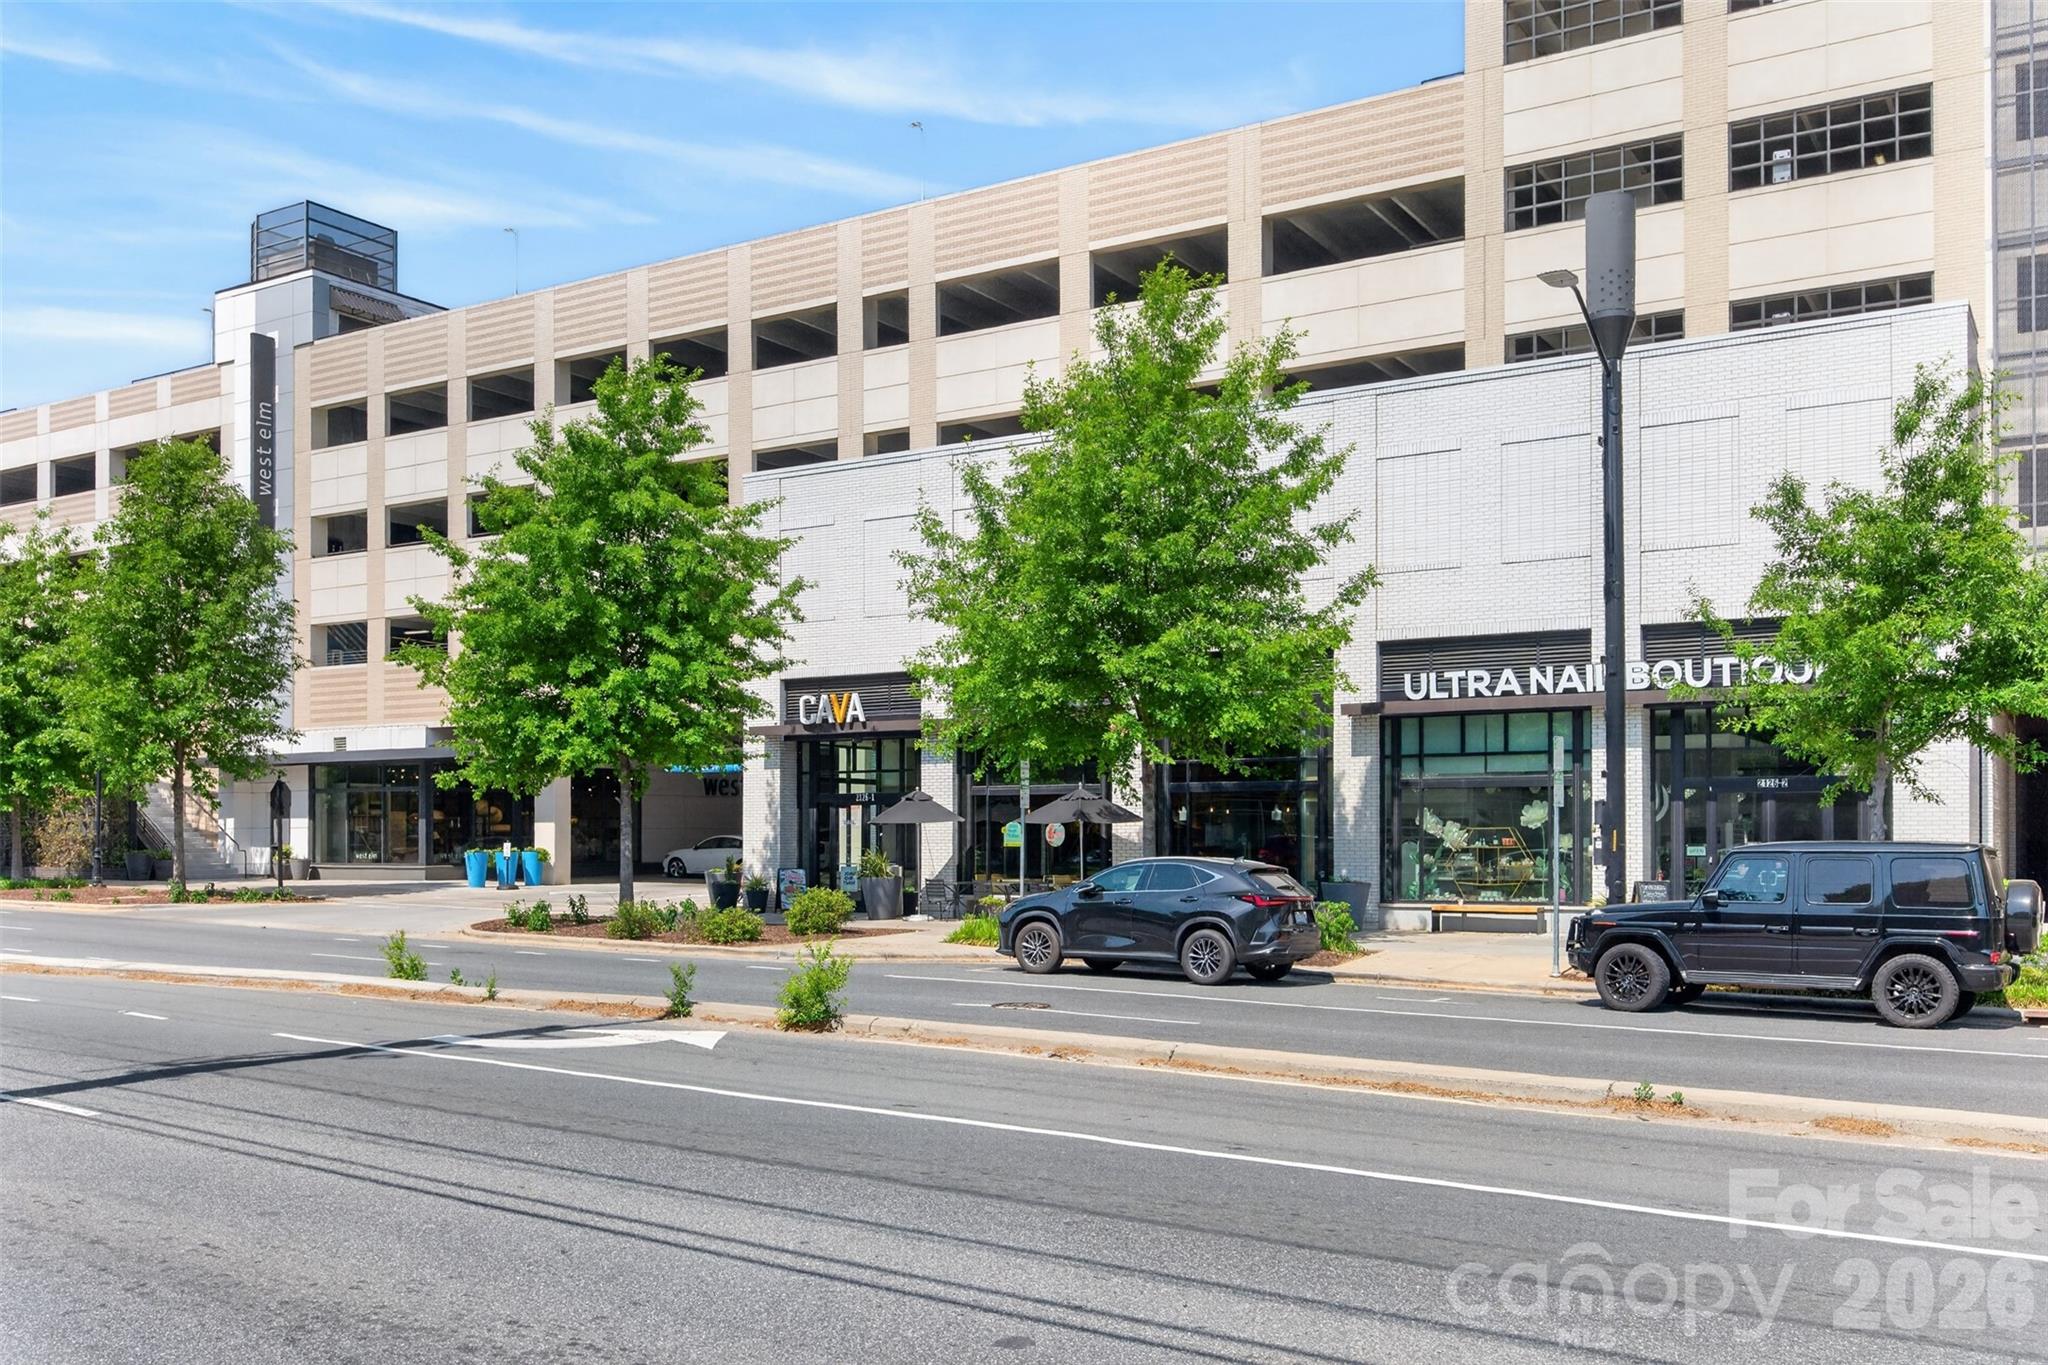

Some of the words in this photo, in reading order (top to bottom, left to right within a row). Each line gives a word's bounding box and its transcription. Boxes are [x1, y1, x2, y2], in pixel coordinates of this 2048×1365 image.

[255, 401, 272, 440] elm
[259, 446, 272, 496] west
[1403, 668, 1523, 701] ULTRA
[799, 692, 866, 725] CAVA
[703, 777, 743, 796] wes
